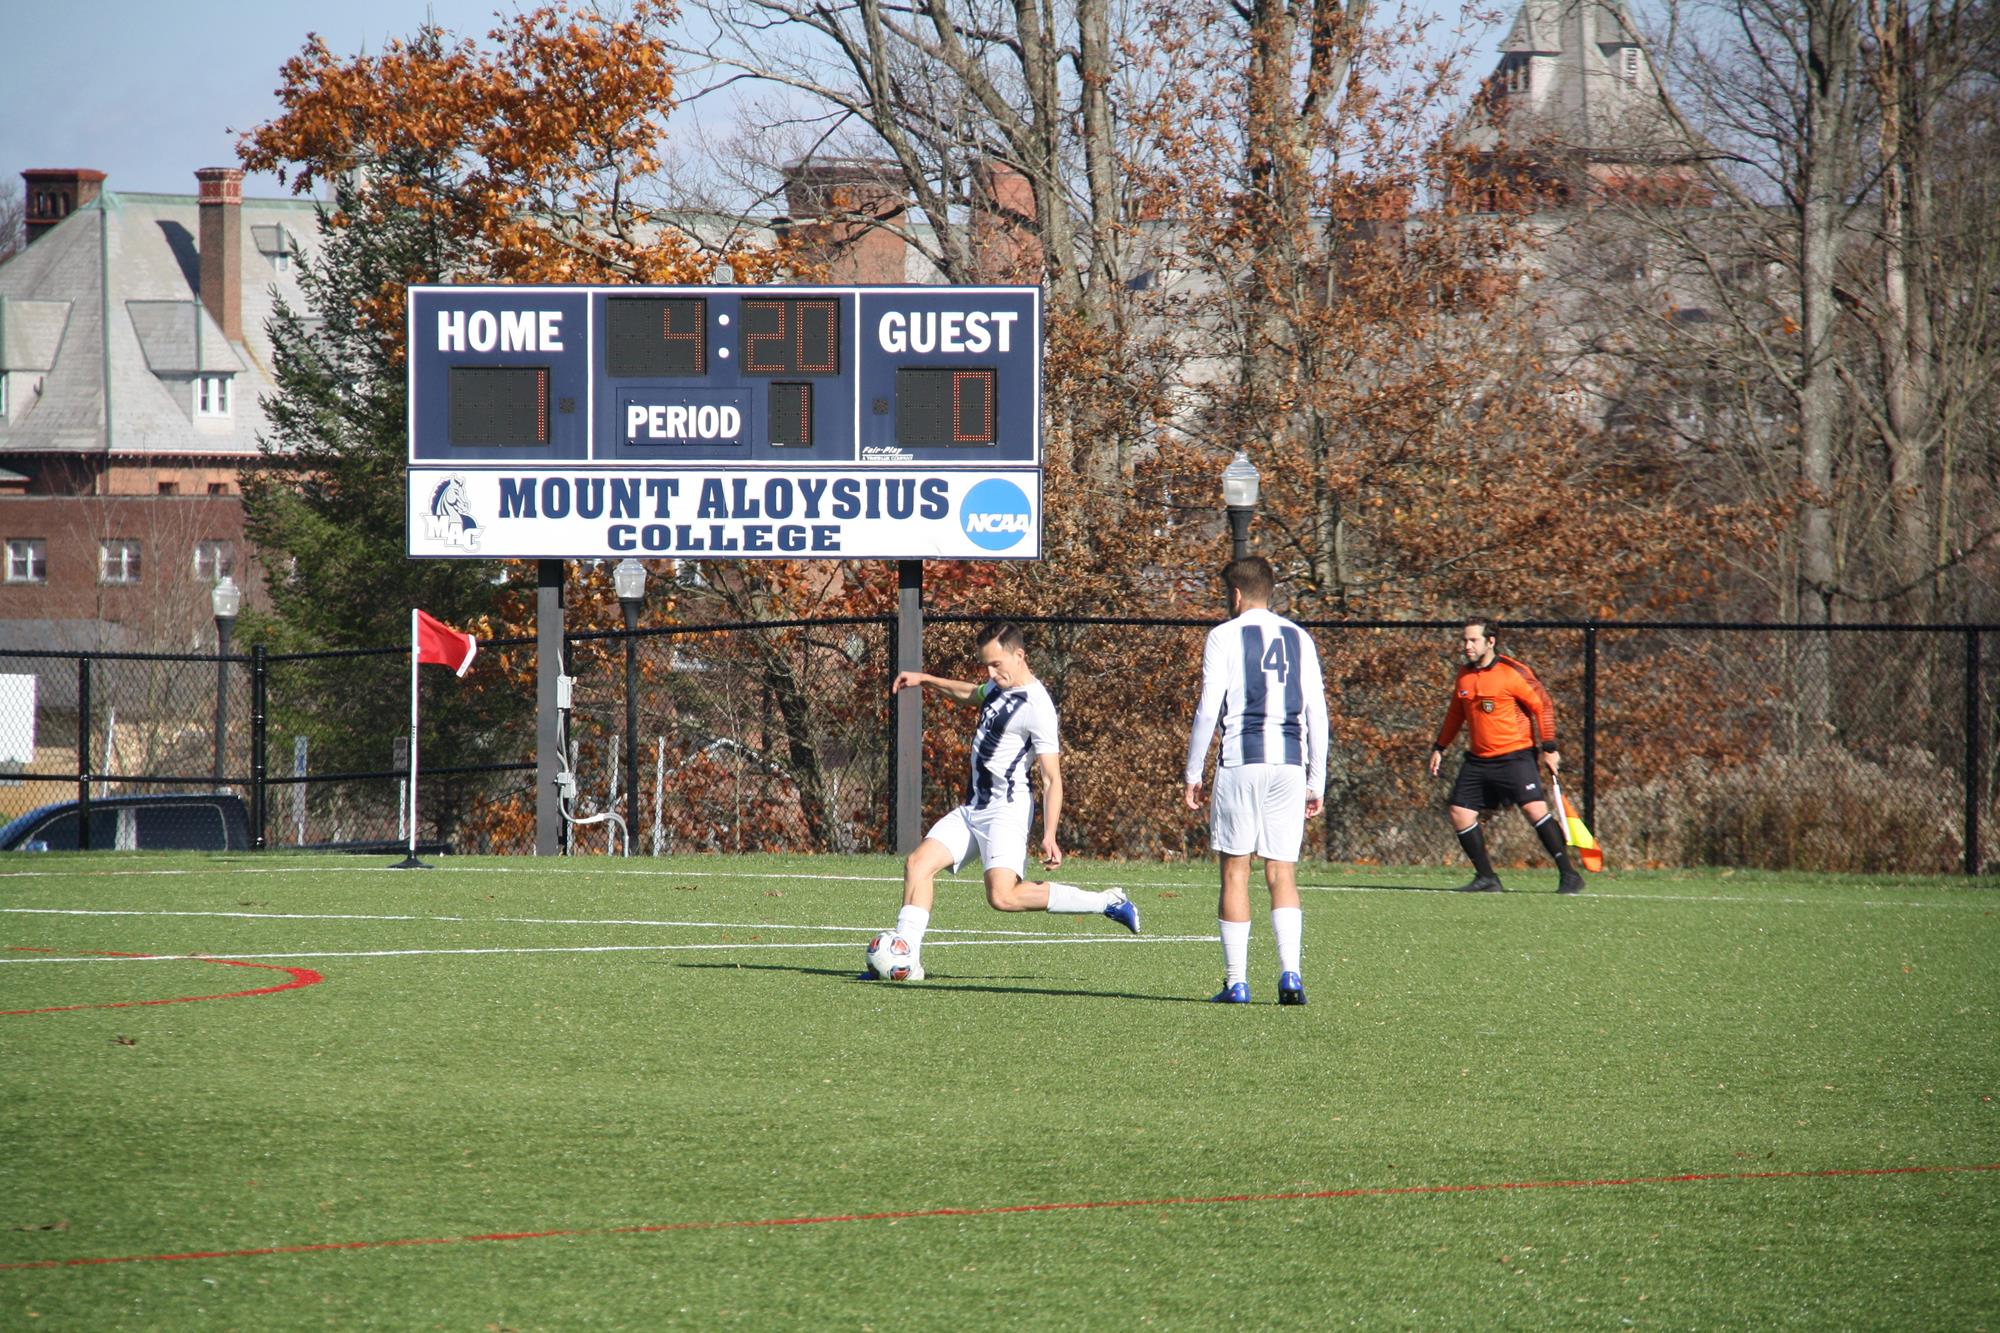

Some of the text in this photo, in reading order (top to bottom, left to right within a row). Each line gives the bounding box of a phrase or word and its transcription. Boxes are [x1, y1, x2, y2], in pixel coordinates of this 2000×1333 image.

[437, 310, 563, 352] HOME
[878, 311, 1019, 353] GUEST
[627, 405, 741, 439] PERIOD
[953, 371, 992, 442] 0
[498, 477, 950, 520] MOUNT ALOYSIUS
[422, 514, 484, 552] MAC
[607, 524, 842, 551] COLLEGE
[966, 513, 1029, 533] NCAA
[1261, 636, 1289, 686] 4
